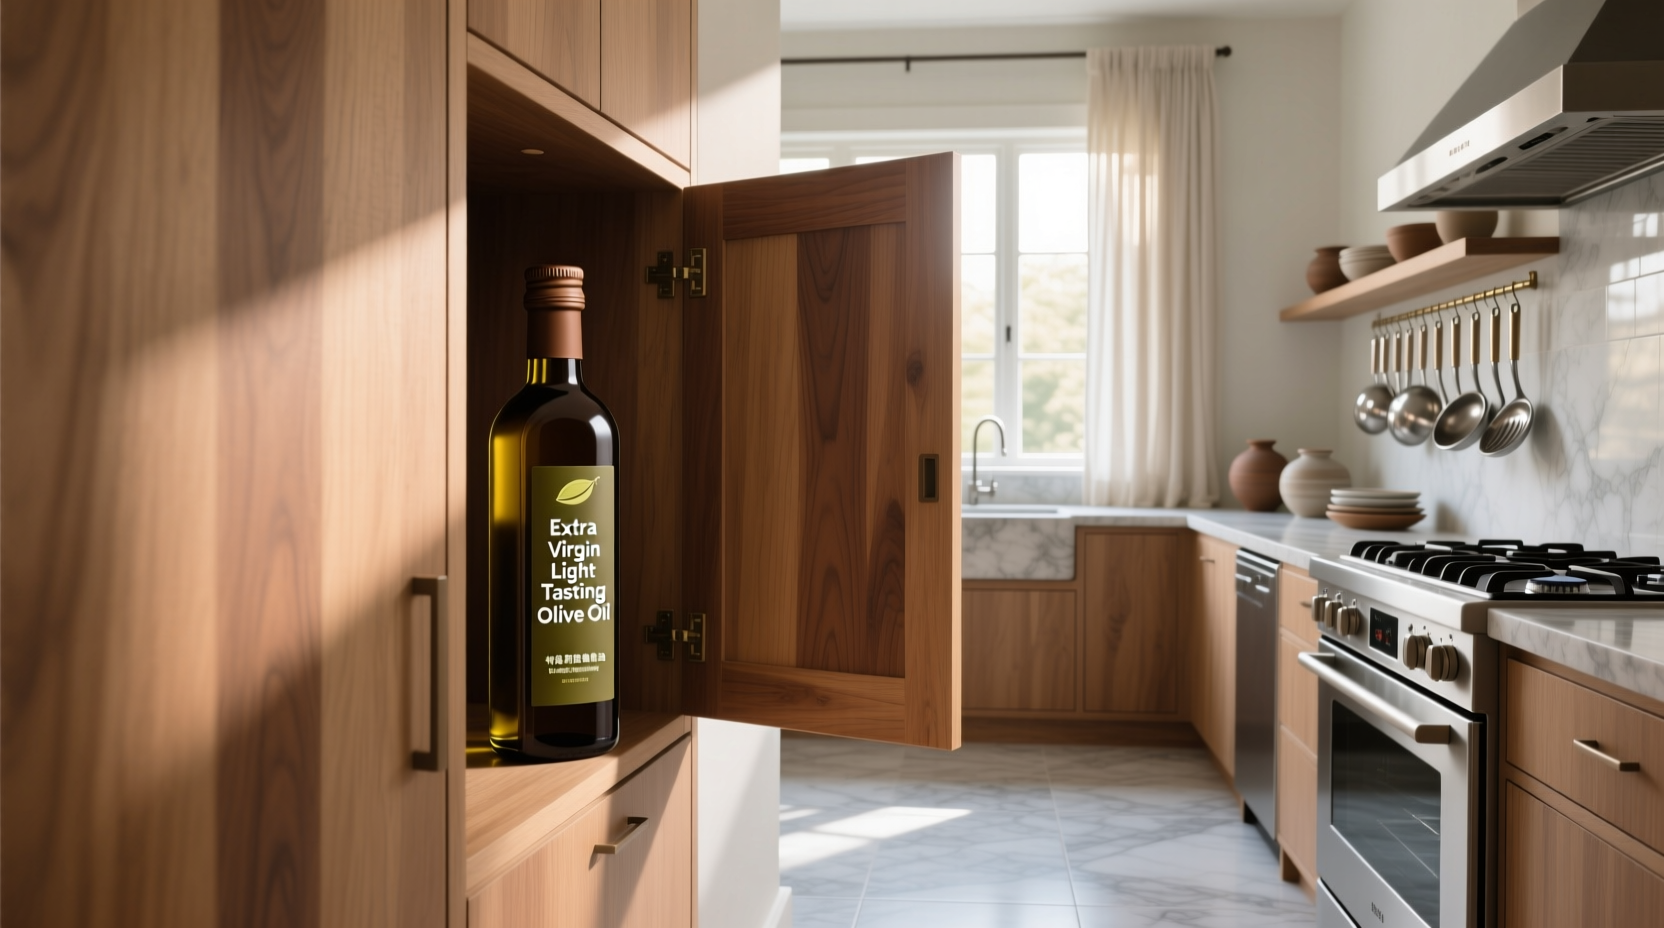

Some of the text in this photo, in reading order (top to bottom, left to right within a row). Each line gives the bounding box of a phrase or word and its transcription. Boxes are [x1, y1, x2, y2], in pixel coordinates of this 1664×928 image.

[550, 518, 597, 536] Extra
[548, 540, 601, 562] Virgin
[551, 561, 596, 584] Light
[541, 583, 606, 604] Tasting
[537, 602, 611, 624] Olive Oil
